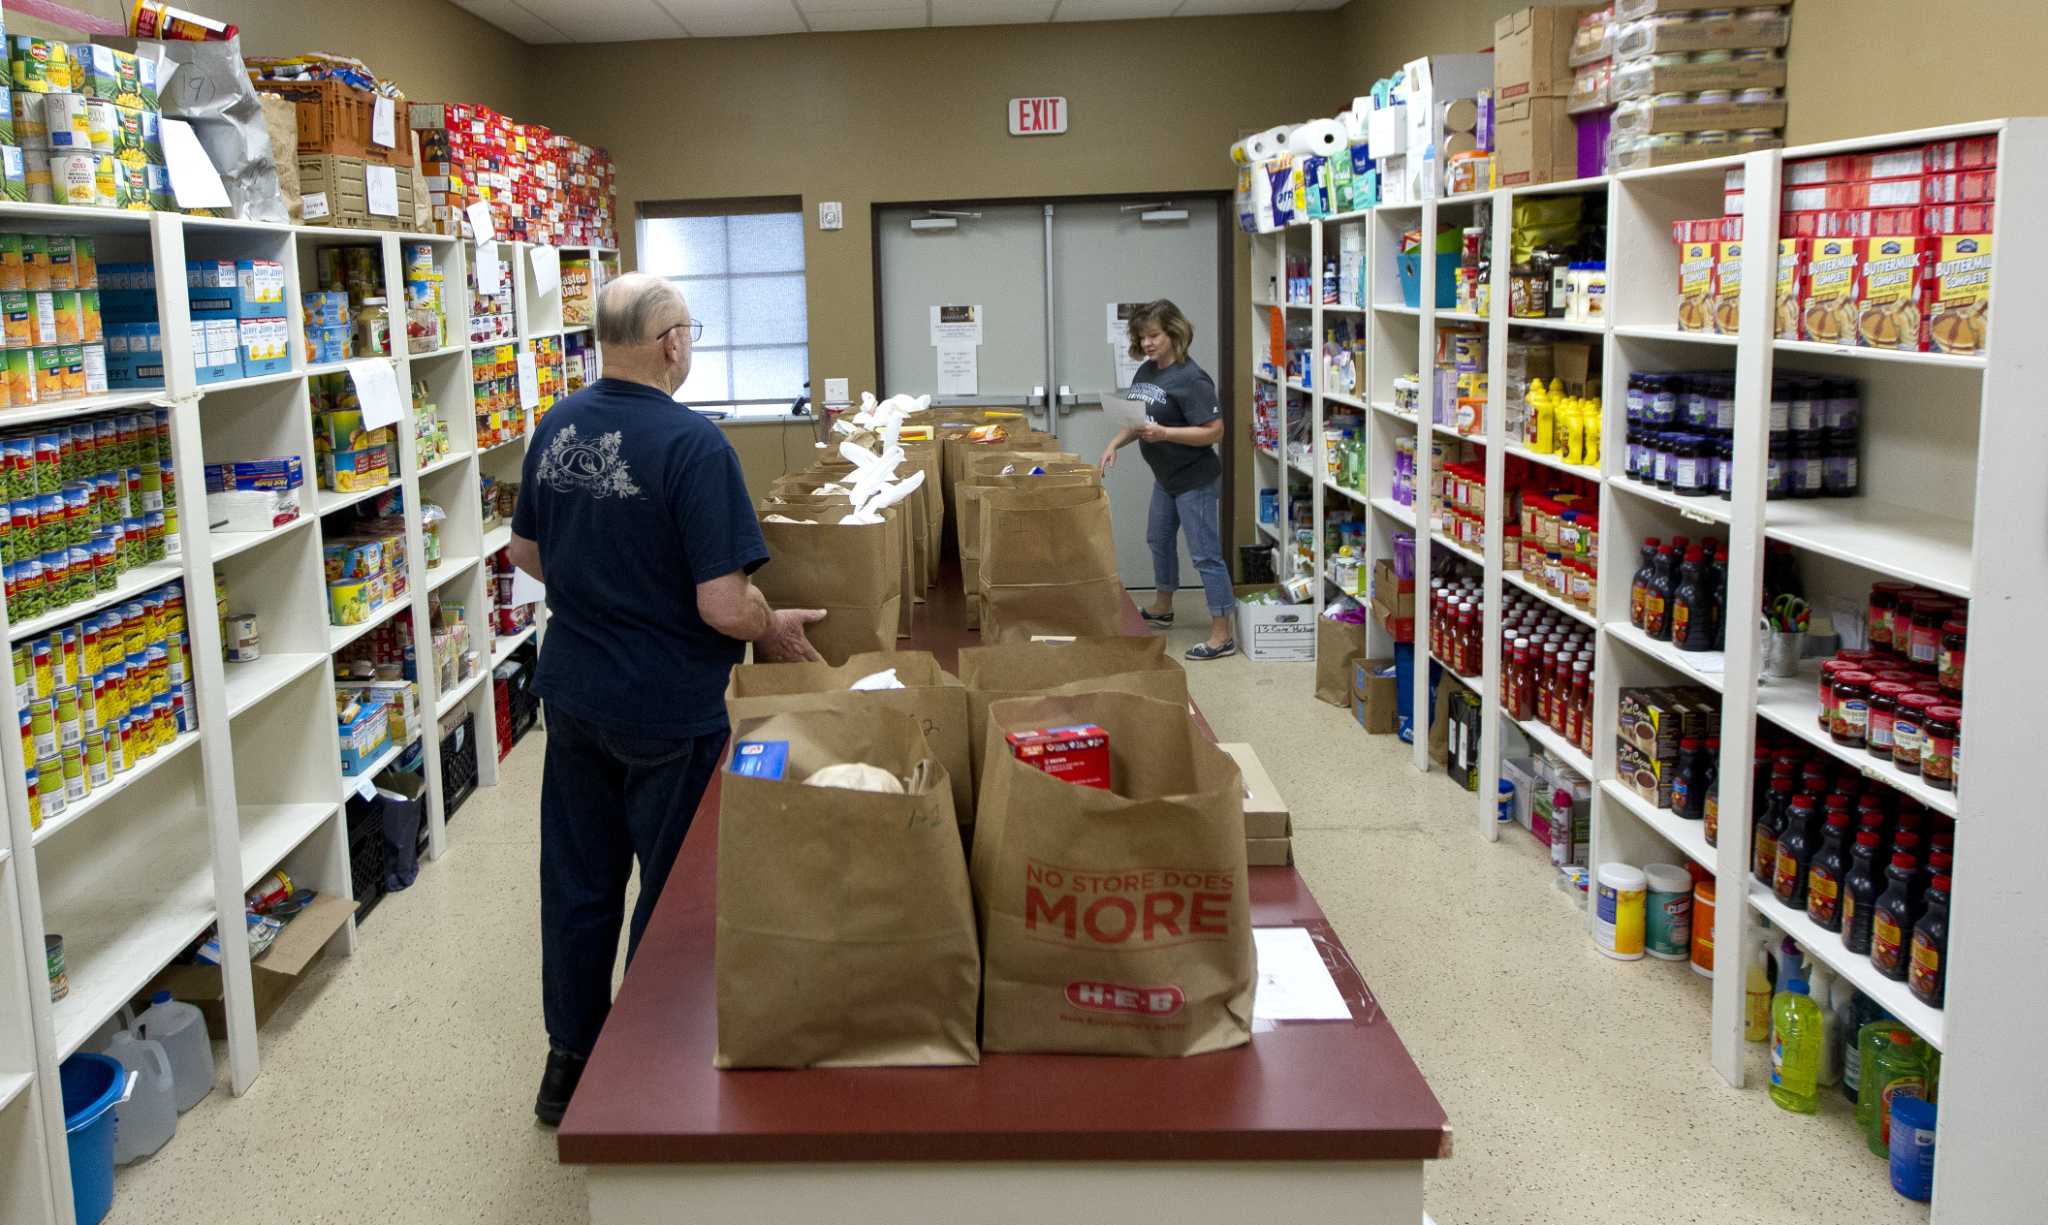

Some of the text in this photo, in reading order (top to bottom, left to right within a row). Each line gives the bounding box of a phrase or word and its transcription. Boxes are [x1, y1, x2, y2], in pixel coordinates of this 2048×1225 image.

[1020, 99, 1059, 130] EXIT
[1863, 253, 1920, 276] BUTTERMILK
[1027, 864, 1233, 893] NO STORE DOES
[1025, 885, 1232, 944] MORE
